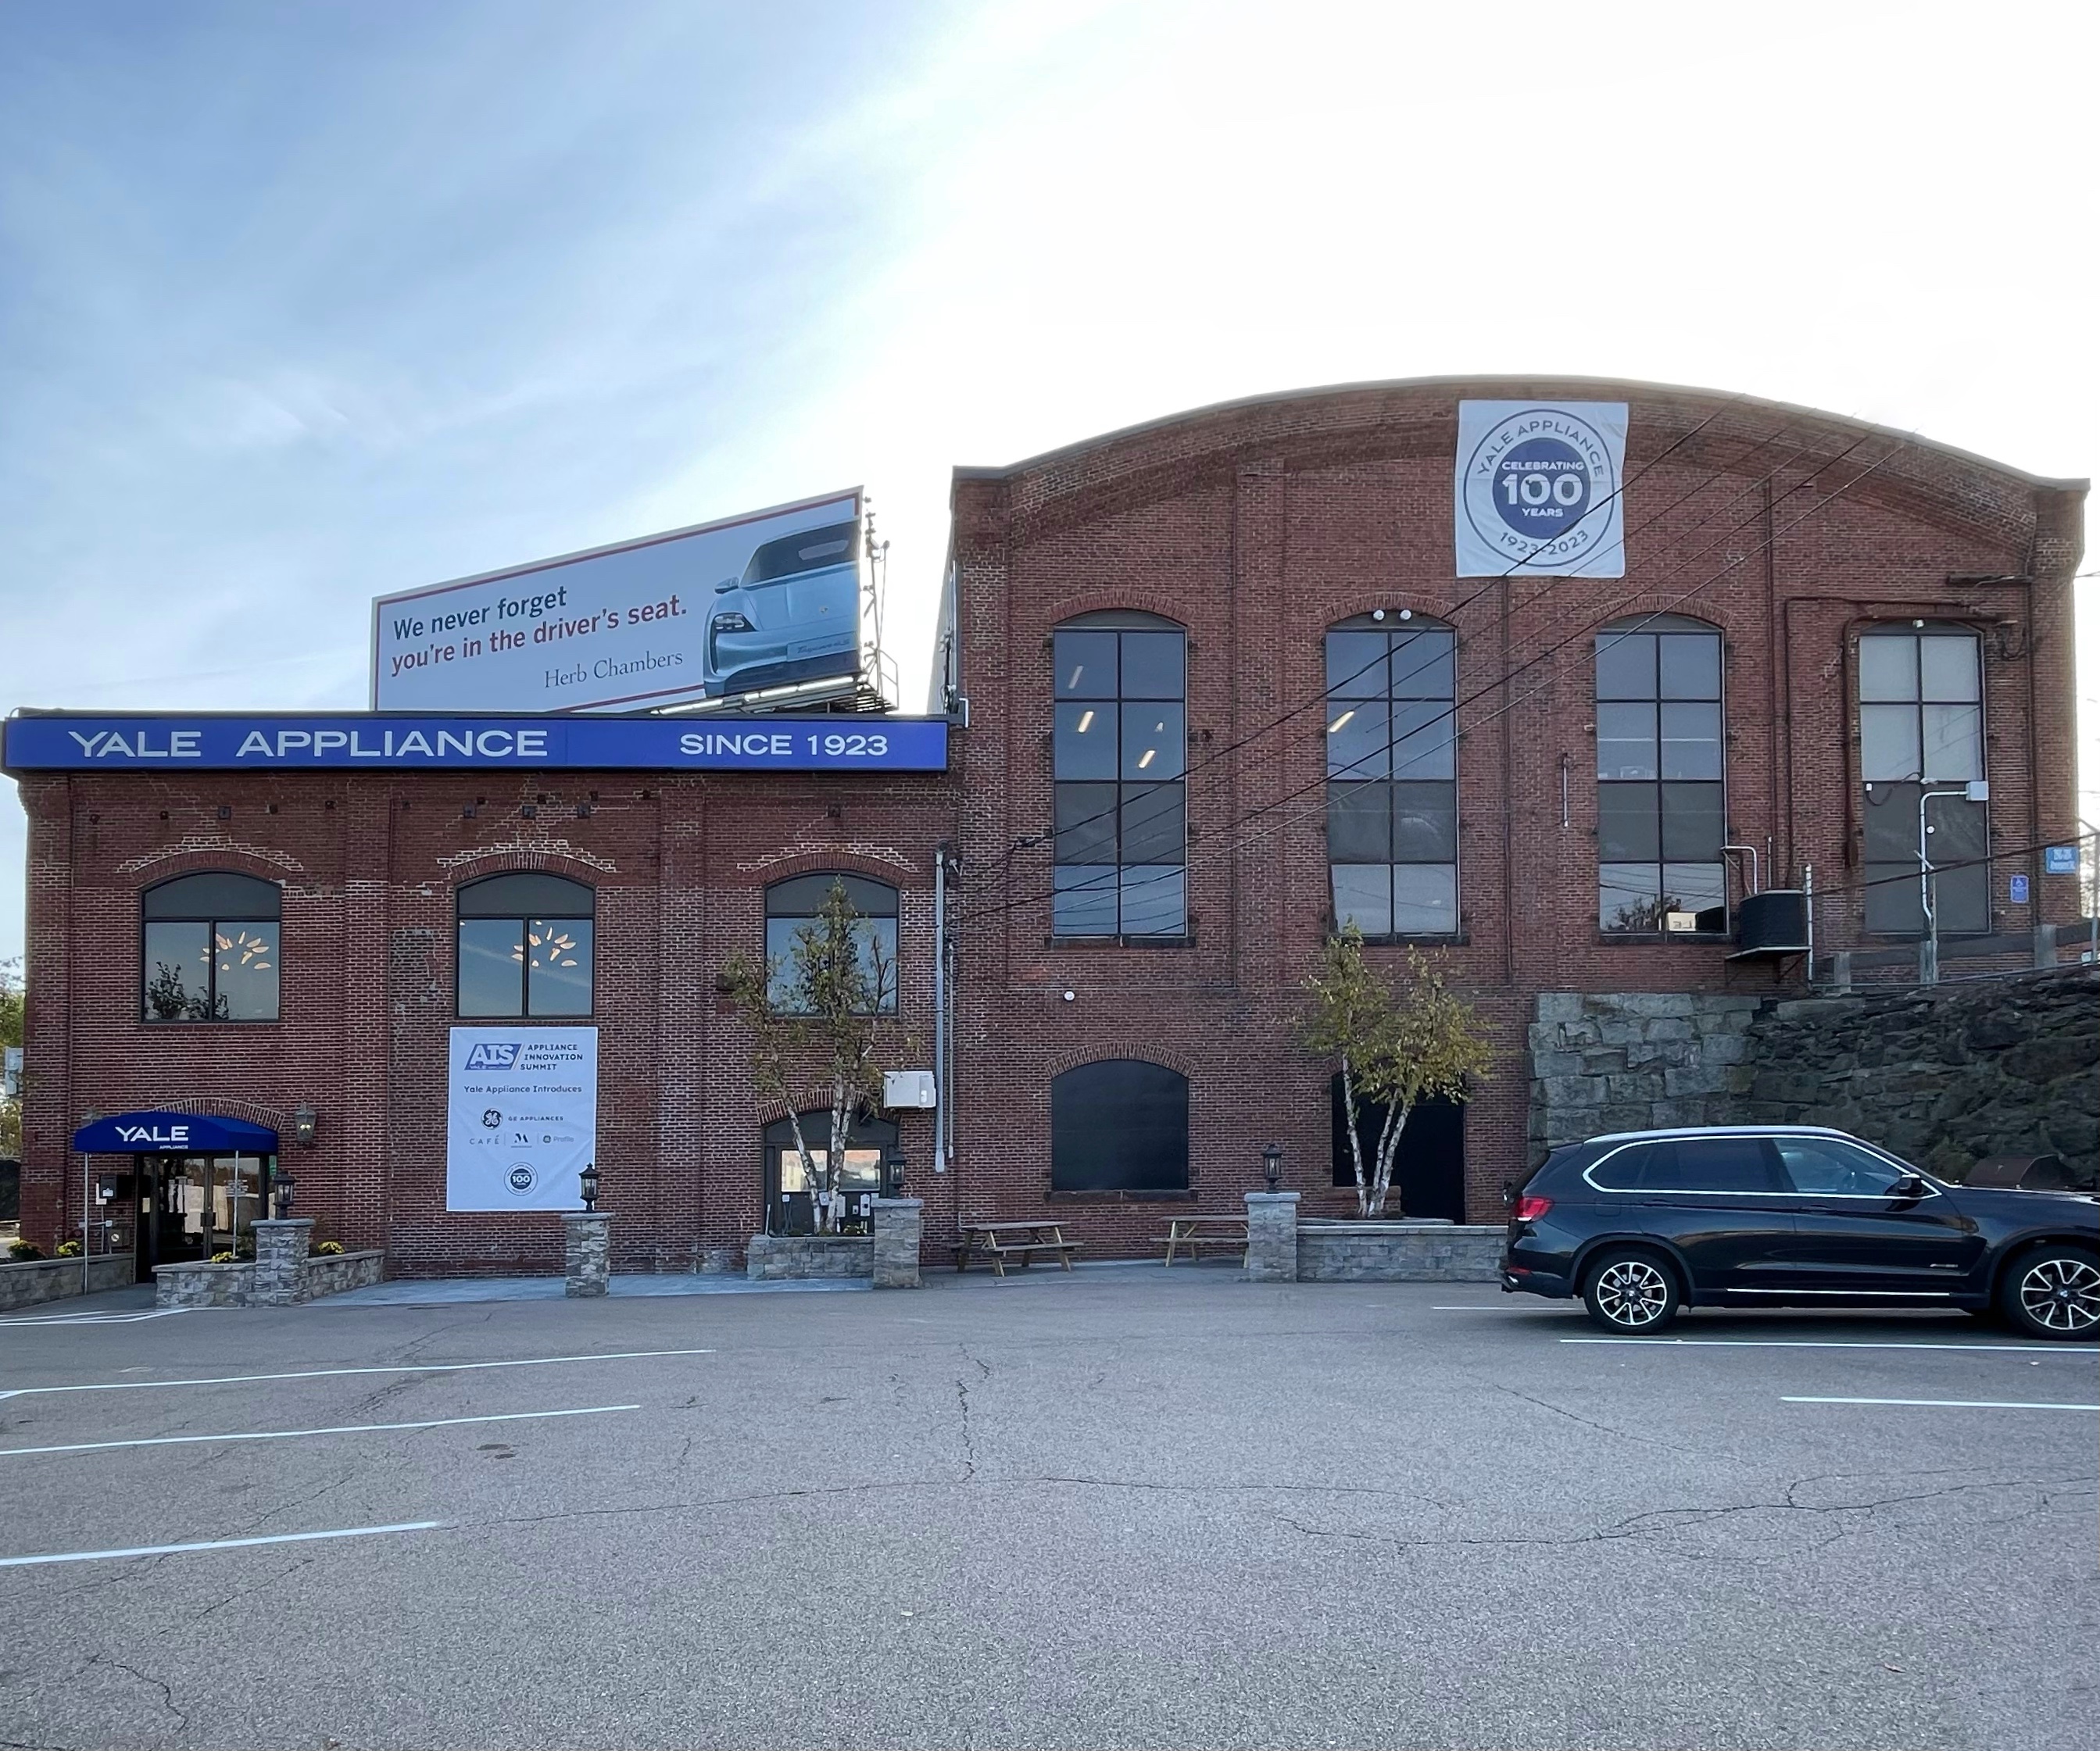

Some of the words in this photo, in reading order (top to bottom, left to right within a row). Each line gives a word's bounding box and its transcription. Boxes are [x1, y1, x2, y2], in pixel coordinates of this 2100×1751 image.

[1478, 431, 1514, 476] YALE
[1518, 420, 1604, 477] APPLIANCE
[1502, 461, 1585, 470] CELEBRATING
[1502, 473, 1583, 506] 100
[1522, 508, 1564, 516] YEARS
[394, 617, 424, 641] We
[431, 606, 490, 634] never
[497, 586, 567, 618] forget
[392, 643, 455, 677] you're
[463, 637, 481, 659] in
[489, 629, 526, 653] the
[533, 608, 620, 644] driver's
[628, 594, 687, 625] seat.
[545, 663, 587, 688] Herb
[593, 650, 684, 679] Chambers
[68, 731, 202, 758] YALE
[236, 730, 548, 758] APPLIANCE
[680, 734, 792, 756] SINCE
[807, 734, 889, 756] 1923
[486, 1085, 531, 1094] Appliance
[114, 1126, 189, 1142] YALE
[469, 1135, 499, 1145] CAFÉ
